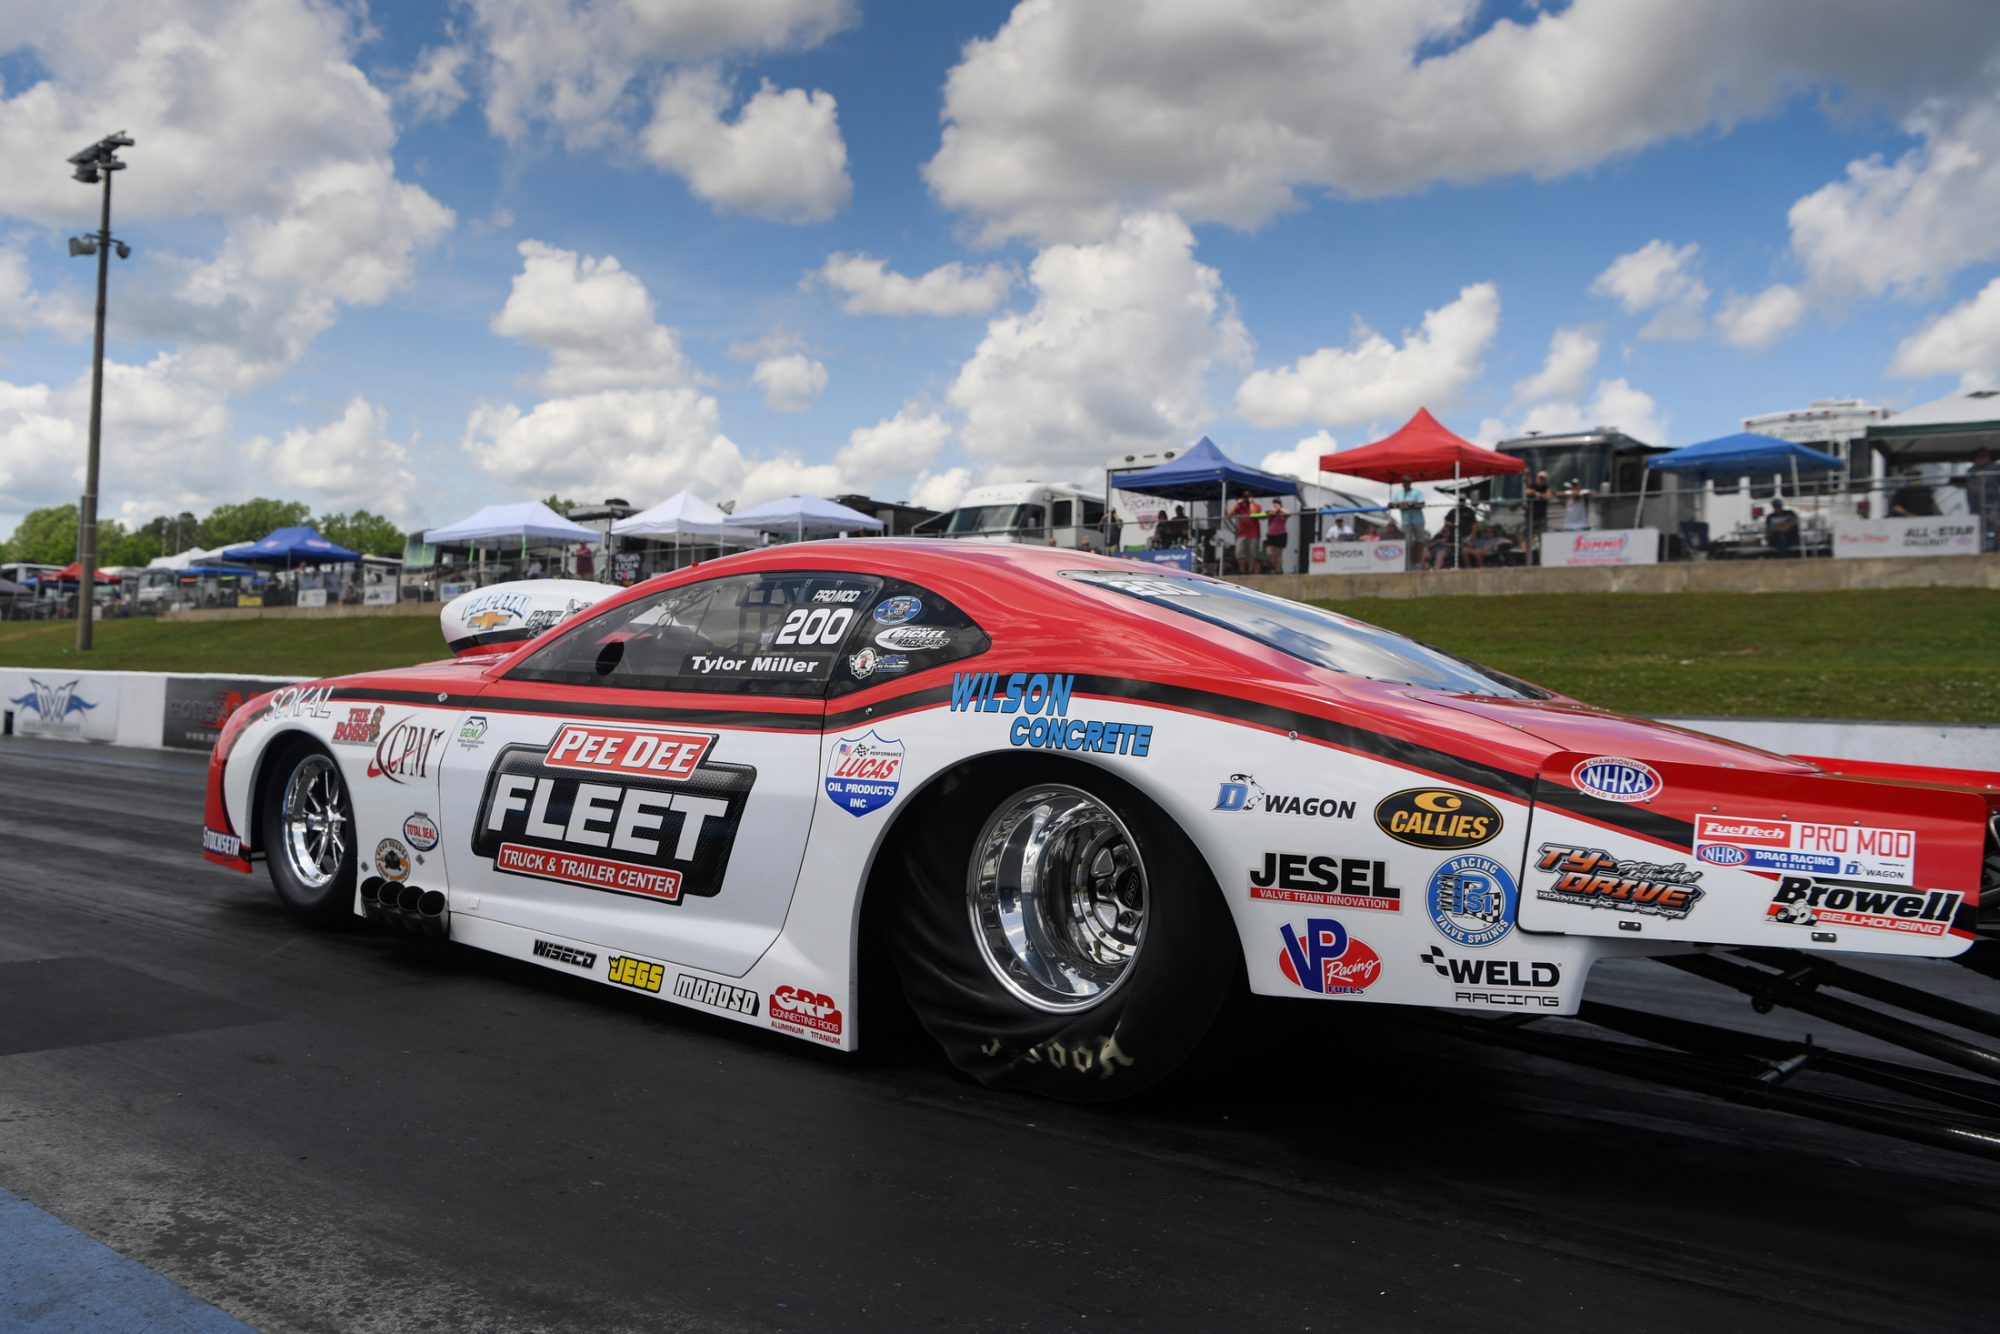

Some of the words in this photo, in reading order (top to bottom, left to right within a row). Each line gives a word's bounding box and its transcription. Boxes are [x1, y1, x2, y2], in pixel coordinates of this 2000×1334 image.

[1330, 550, 1364, 559] TOYOTA
[525, 610, 564, 627] PAT
[775, 608, 854, 645] 200
[891, 629, 946, 638] BICKEL
[894, 638, 922, 648] RACE
[920, 638, 951, 649] CARS
[691, 656, 746, 674] Tylor
[750, 656, 819, 673] Miller
[263, 685, 335, 721] SOKAL
[949, 671, 1074, 717] WILSON
[347, 707, 372, 722] THE
[332, 721, 370, 742] BOSS
[460, 727, 478, 738] GEM
[1010, 715, 1154, 758] CONCRETE
[387, 724, 437, 778] CPM
[552, 729, 625, 766] PEE
[620, 735, 702, 773] DEE
[834, 757, 899, 779] LUCAS
[1587, 758, 1648, 772] CHAMPIONSHIP
[827, 782, 843, 793] OIL
[845, 783, 895, 797] PRODUCTS
[1586, 765, 1648, 793] NHRA
[1211, 782, 1249, 812] D
[1265, 794, 1357, 820] WAGON
[1585, 786, 1607, 799] DRAG
[487, 773, 730, 862] FLEET
[1390, 809, 1489, 840] CALLIES
[406, 824, 421, 838] TOTAL
[422, 827, 436, 840] SEAL
[1703, 822, 1785, 840] FuelTech
[1800, 825, 1848, 853] PRO
[1857, 829, 1911, 858] MOD
[1450, 857, 1499, 874] RACING
[1705, 847, 1746, 864] NHRA
[1755, 850, 1788, 864] DRAG
[1789, 852, 1835, 866] RACING
[1775, 861, 1814, 872] SERIES
[502, 849, 545, 871] TRUCK
[546, 859, 557, 872] &
[560, 859, 616, 883] TRAILER
[617, 869, 676, 895] CENTER
[1250, 852, 1400, 899] JESEL
[1866, 869, 1905, 879] WAGON
[1259, 888, 1292, 901] VALVE
[1294, 891, 1325, 904] TRAIN
[1326, 894, 1390, 910] INNOVATION
[1556, 873, 1696, 907] DRIVE
[1772, 875, 1961, 922] Browell
[1436, 914, 1465, 941] VALVE
[1467, 919, 1509, 944] SPRINGS
[1817, 911, 1942, 935] BELLHOUSING
[1279, 917, 1348, 994] VP
[608, 955, 665, 993] JEGS
[1327, 957, 1381, 984] Racing
[1447, 958, 1560, 988] WELD
[674, 973, 758, 1016] MOROSO
[774, 984, 836, 1019] GRP
[1328, 984, 1364, 995] FUELS
[1455, 991, 1560, 1008] RACING
[771, 1008, 817, 1027] CONNECTING
[817, 1020, 839, 1032] RODS
[771, 1020, 805, 1036] ALUMINUM
[810, 1030, 841, 1045] TITANIUM
